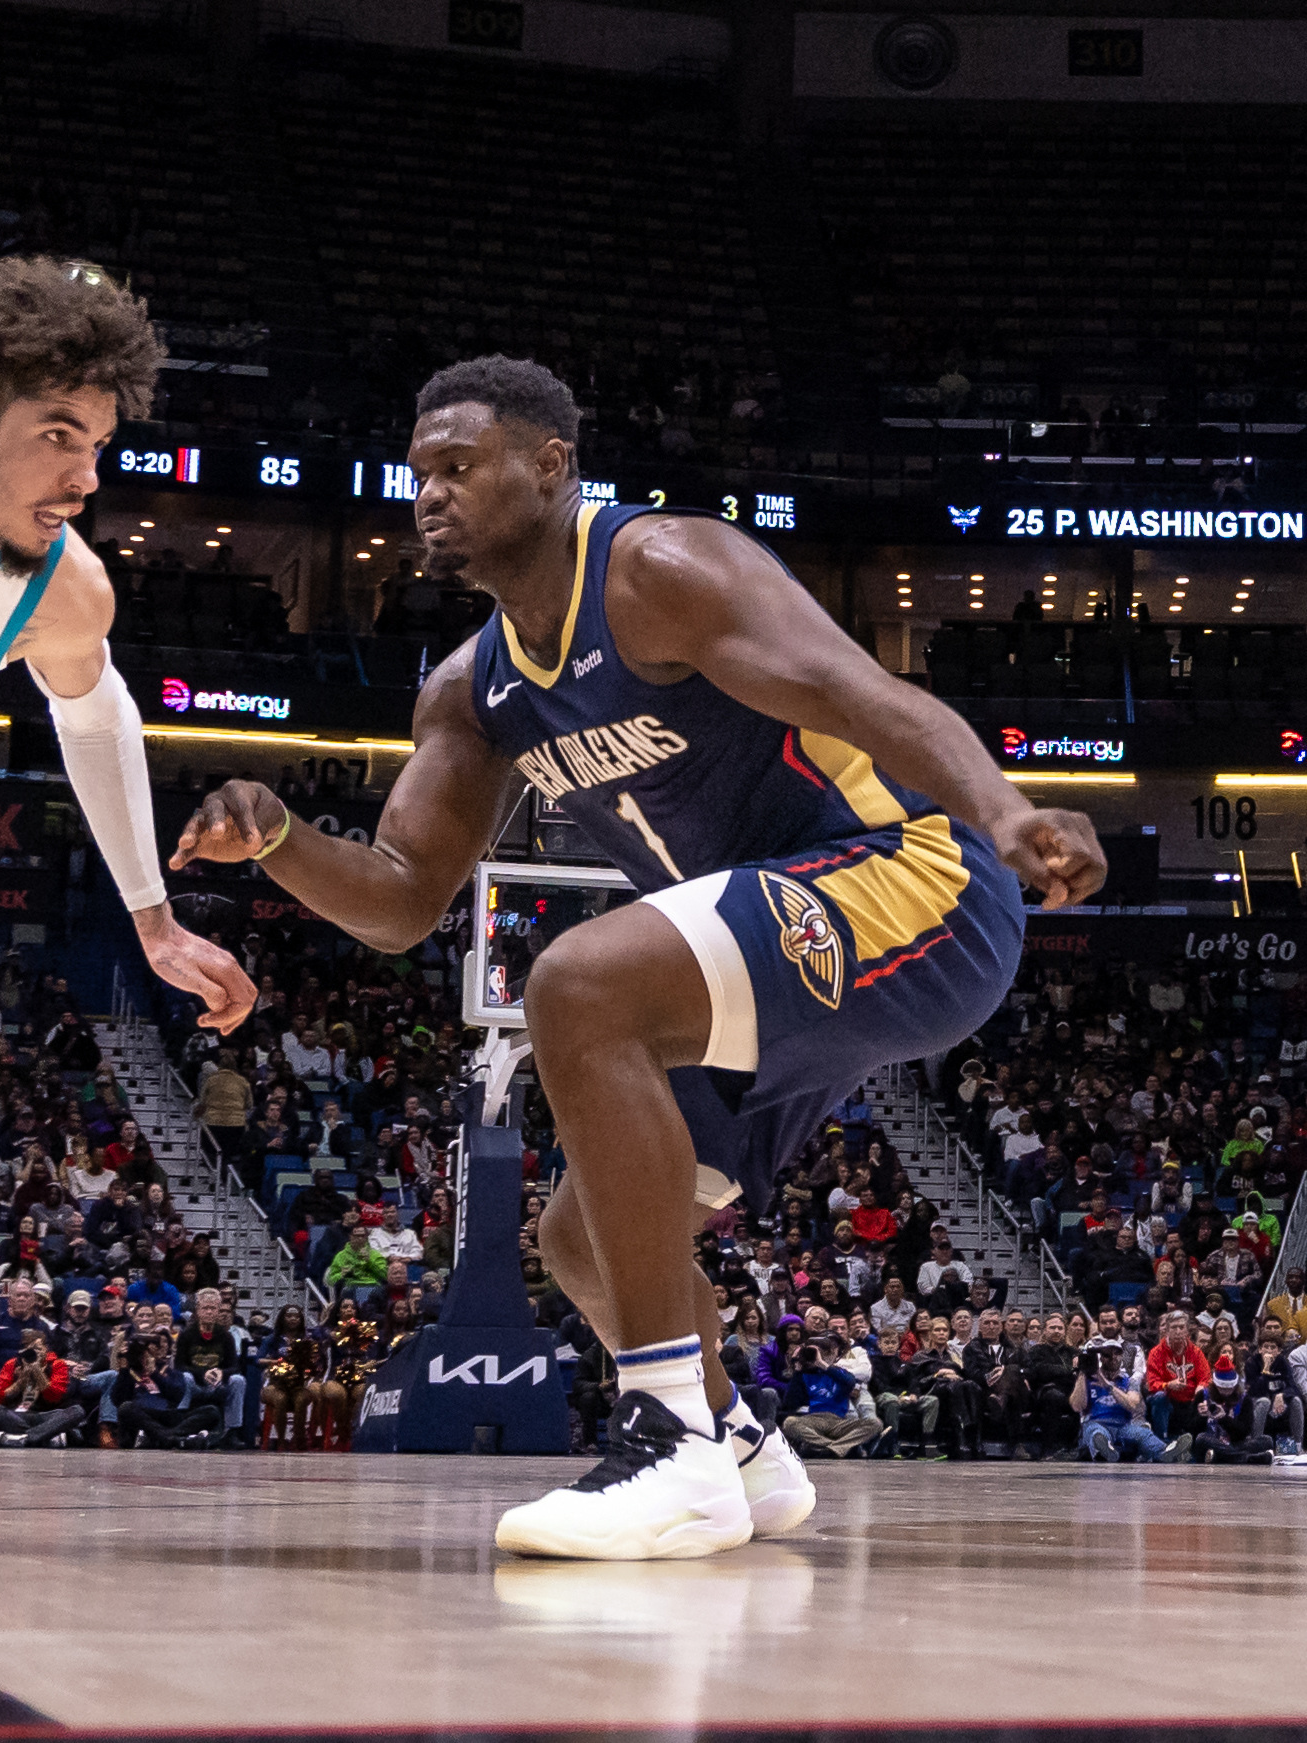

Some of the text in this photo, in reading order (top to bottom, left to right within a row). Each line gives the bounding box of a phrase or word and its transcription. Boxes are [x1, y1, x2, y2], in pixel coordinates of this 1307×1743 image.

[120, 450, 173, 475] 9:20
[260, 456, 300, 486] 85
[580, 481, 616, 500] EAM
[755, 494, 795, 512] TIME
[720, 494, 739, 521] 3
[755, 511, 796, 529] OUTS
[1007, 508, 1304, 539] 25 P. WASHINGTON
[572, 648, 604, 679] ibotta
[193, 690, 291, 719] entergy
[555, 713, 690, 790] ORLEANS
[1032, 736, 1124, 761] entergy
[1191, 796, 1258, 841] 108
[614, 791, 686, 883] 1
[1184, 931, 1297, 961] Let's Go
[429, 1354, 547, 1386] KIA
